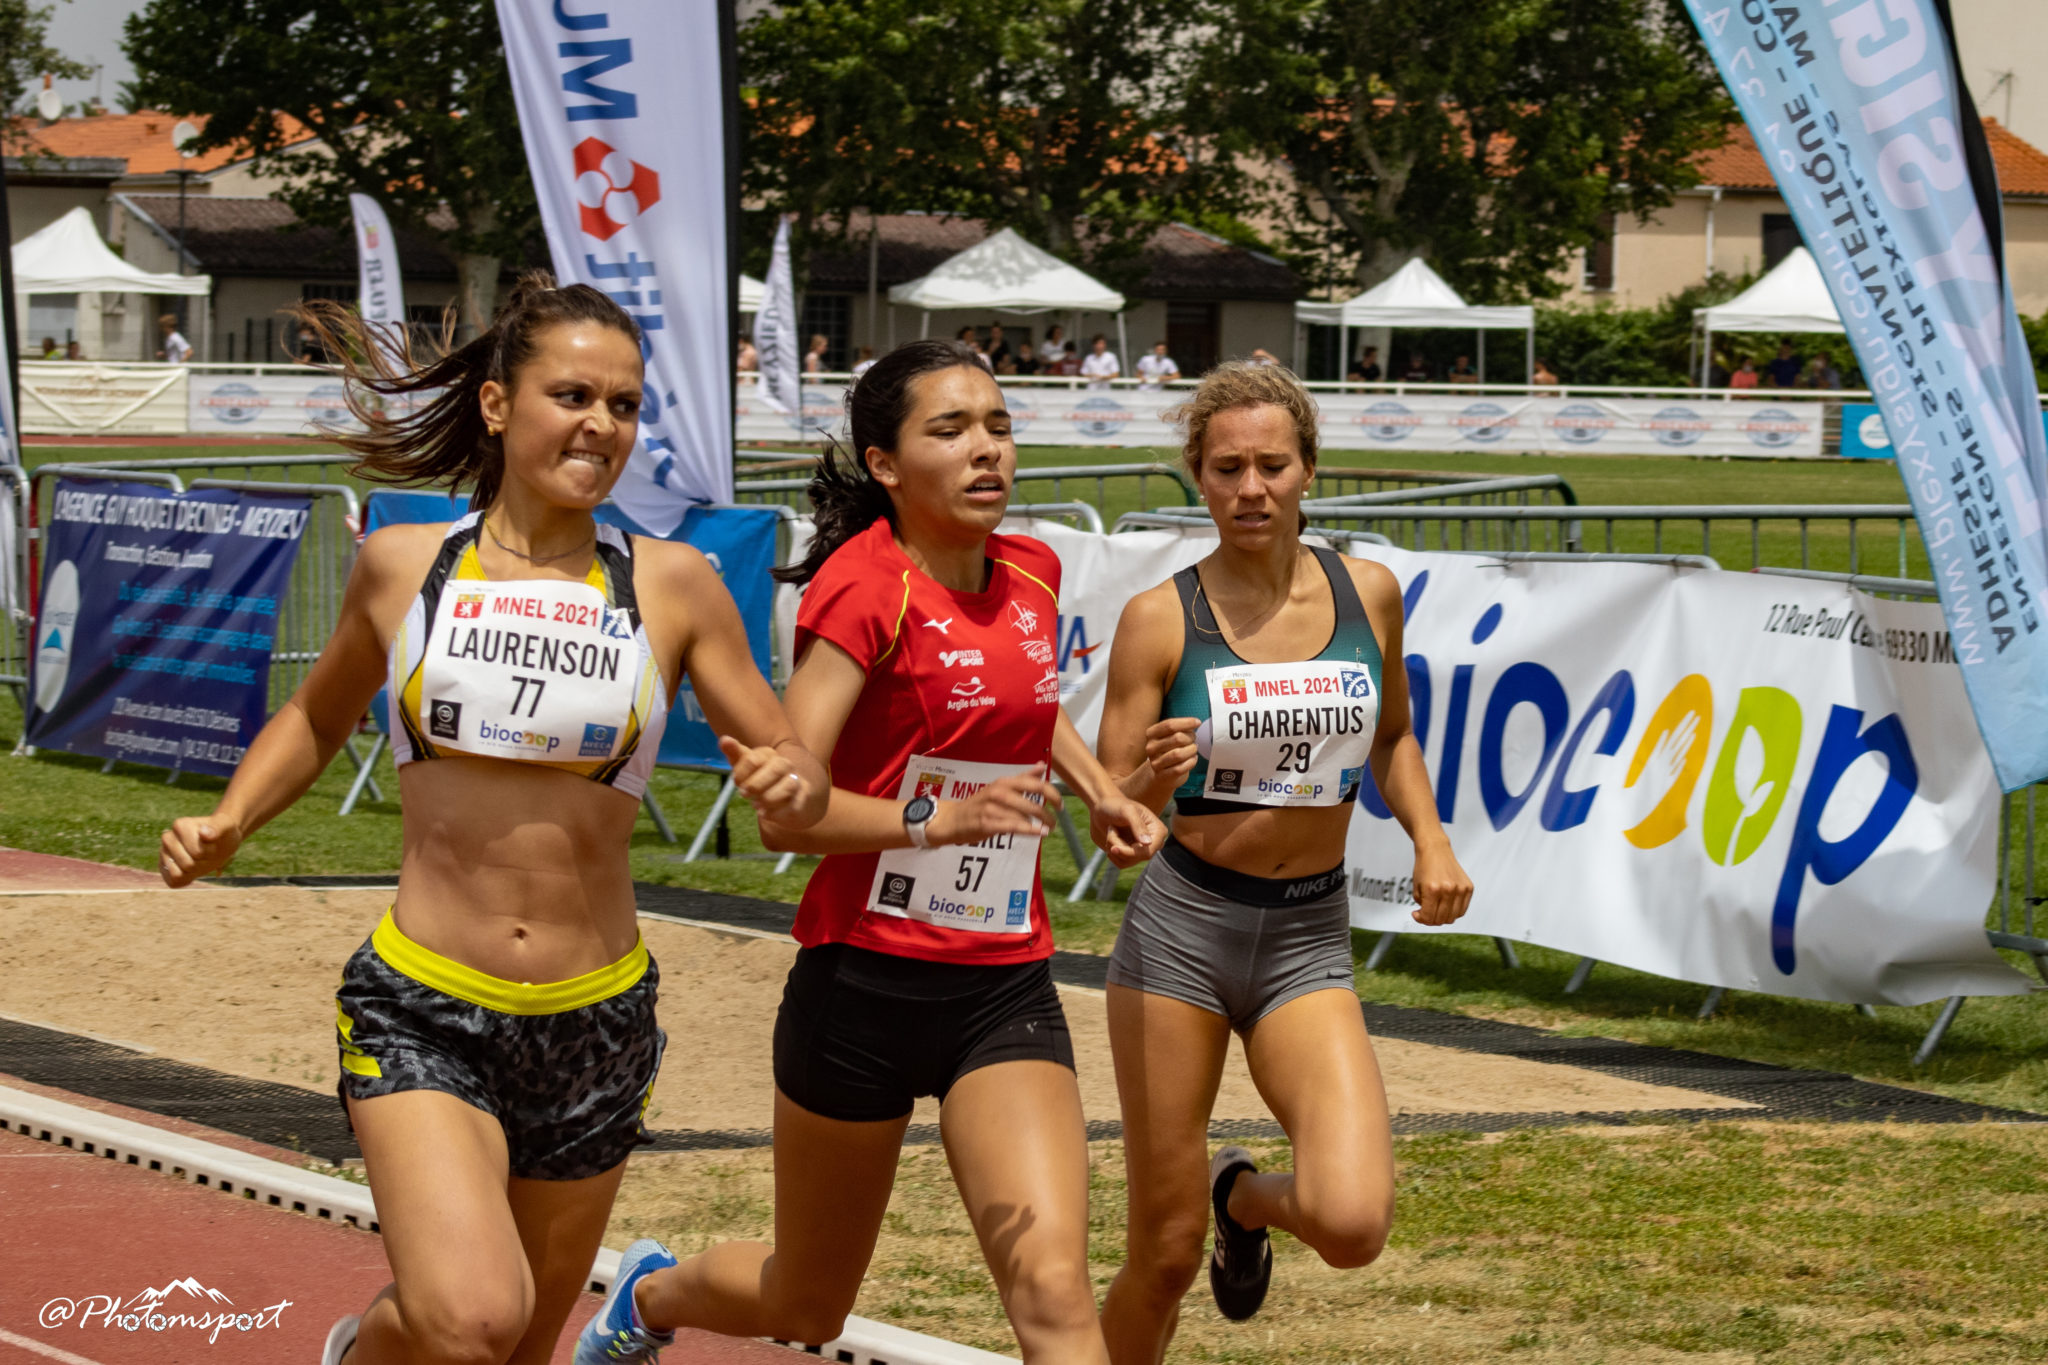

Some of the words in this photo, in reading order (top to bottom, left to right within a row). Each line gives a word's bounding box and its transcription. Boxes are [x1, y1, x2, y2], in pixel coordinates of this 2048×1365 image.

[493, 596, 546, 619] MNEL
[553, 602, 599, 628] 2021
[1763, 603, 1787, 633] 12
[1781, 604, 1814, 637] Rue
[1810, 607, 1854, 641] Paul
[446, 626, 621, 682] LAURENSON
[509, 674, 547, 719] 77
[1254, 679, 1300, 698] MNEL
[1303, 676, 1341, 695] 2021
[479, 719, 561, 754] biocoop
[1228, 705, 1365, 741] CHARENTUS
[1275, 741, 1312, 774] 29
[1258, 778, 1324, 799] biocoop
[954, 855, 990, 893] 57
[1284, 875, 1330, 899] NIKE
[928, 894, 995, 923] biocoop
